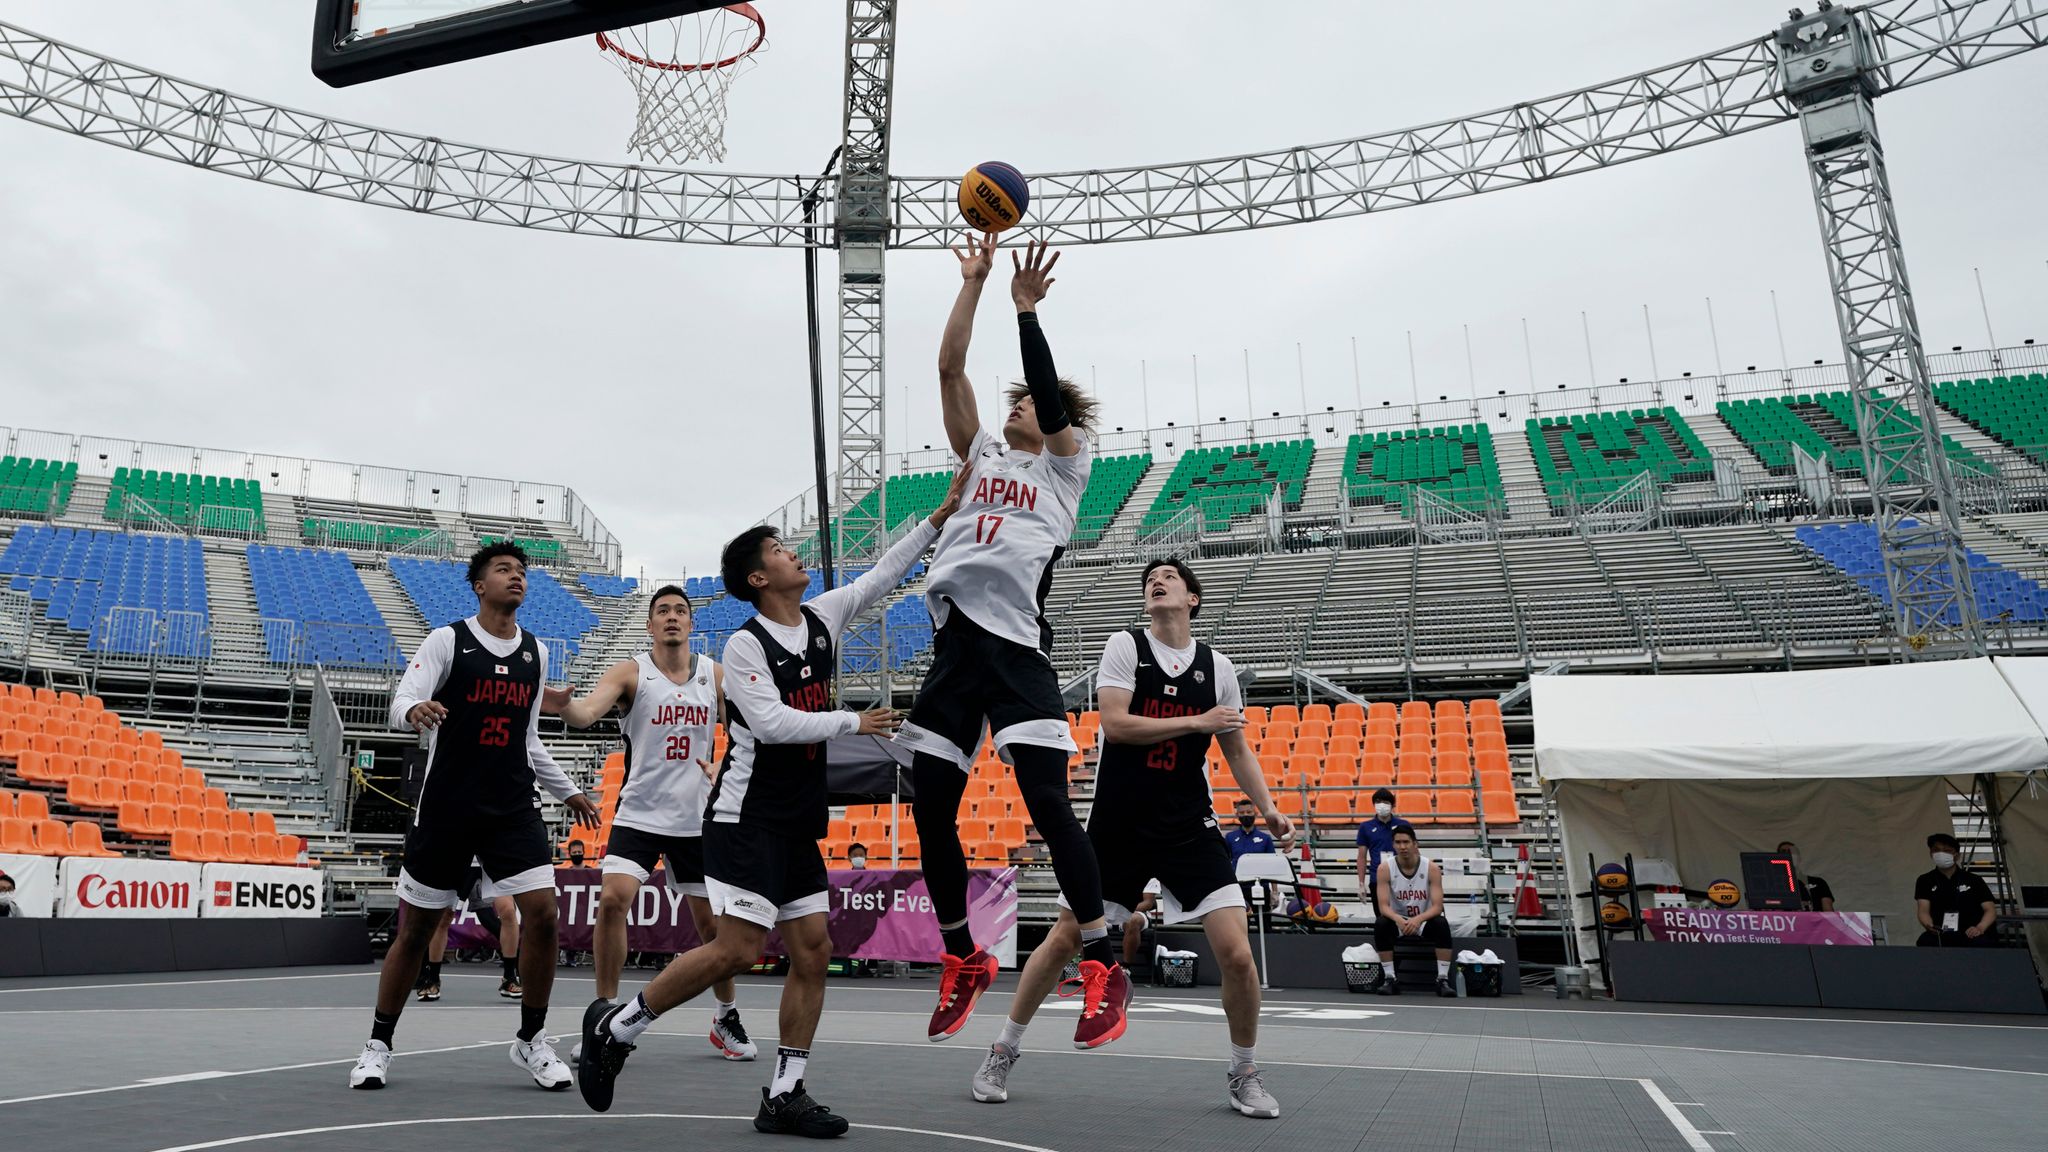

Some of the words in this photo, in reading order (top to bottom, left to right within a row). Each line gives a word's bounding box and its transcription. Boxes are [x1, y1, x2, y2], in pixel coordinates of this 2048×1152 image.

[975, 181, 1013, 222] Wilson
[972, 477, 1038, 512] APAN
[976, 514, 1004, 545] 17
[466, 678, 531, 708] JAPAN
[651, 705, 709, 726] JAPAN
[479, 716, 512, 747] 25
[666, 735, 691, 760] 29
[1146, 740, 1178, 771] 23
[1770, 859, 1796, 893] 7
[76, 874, 190, 909] Canon
[236, 882, 316, 910] ENEOS
[554, 885, 686, 926] TEDY
[839, 888, 885, 911] Test
[1396, 890, 1427, 901] JAPAN
[1407, 905, 1420, 917] 20
[1663, 911, 1721, 930] READY
[1726, 913, 1797, 932] STEADY
[1727, 934, 1746, 943] Test
[1750, 934, 1781, 944] Events
